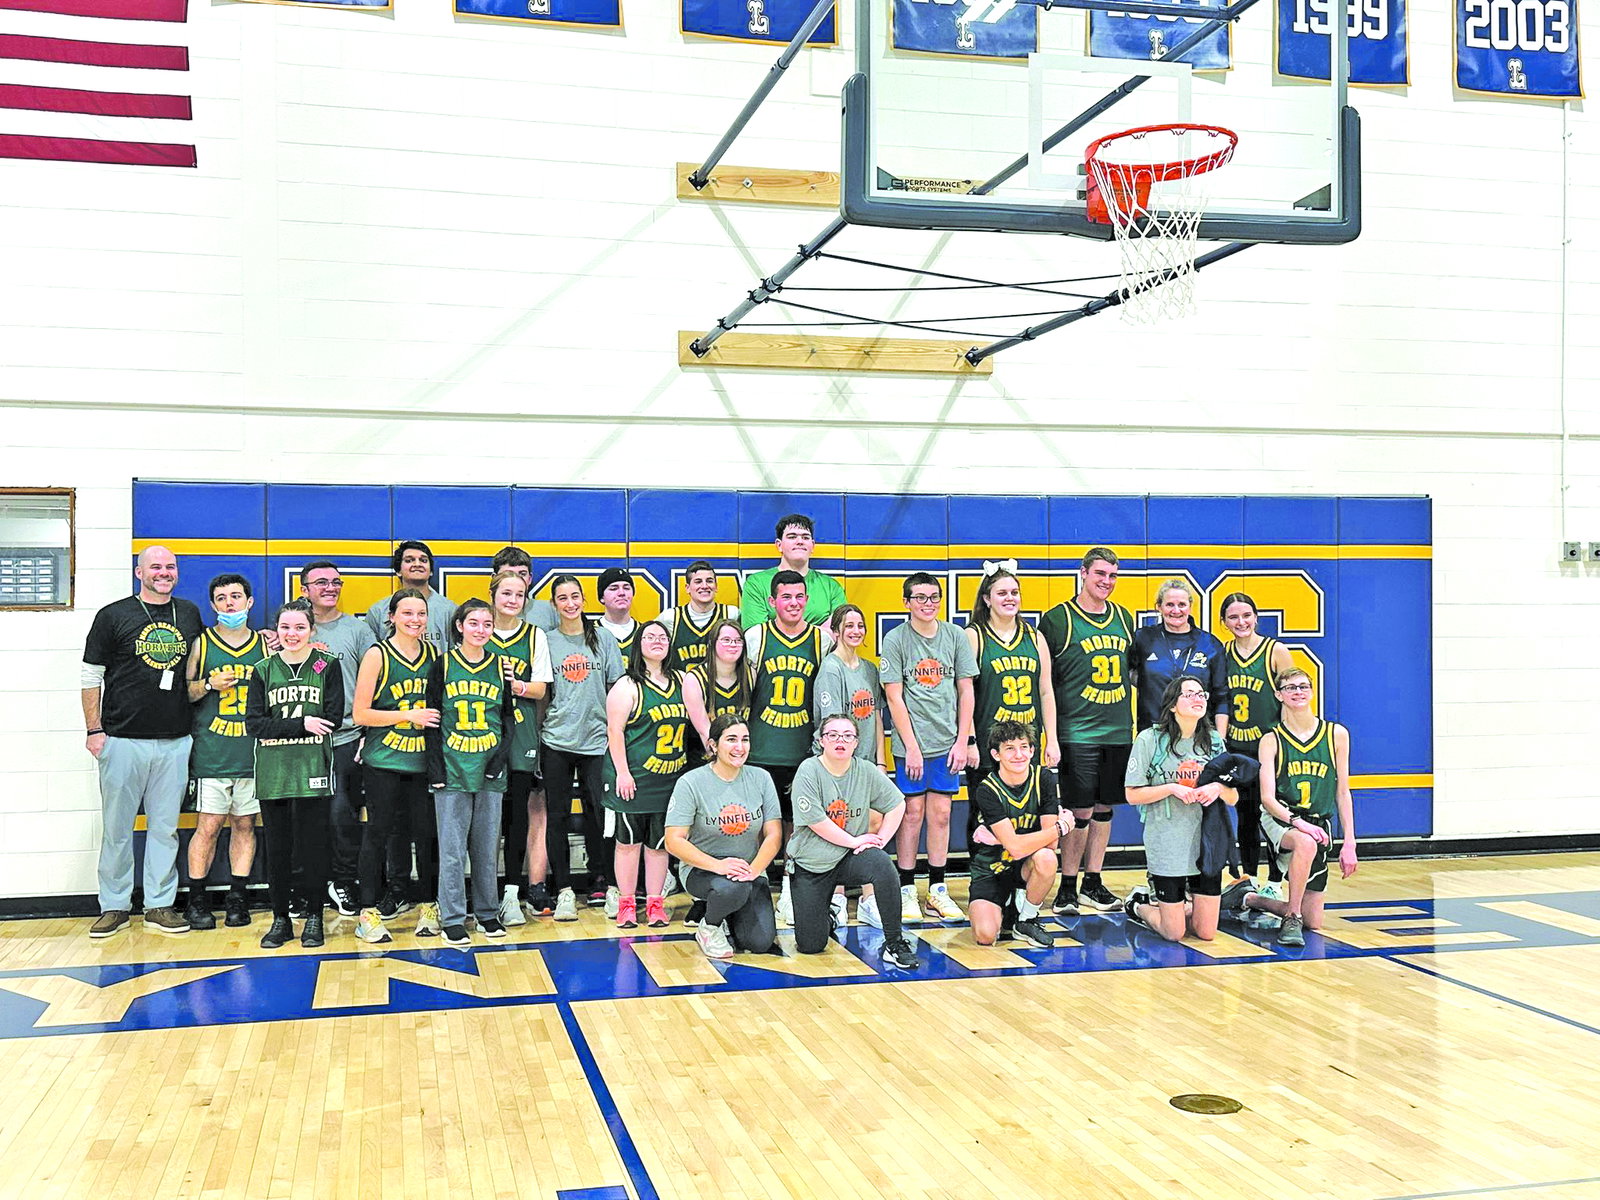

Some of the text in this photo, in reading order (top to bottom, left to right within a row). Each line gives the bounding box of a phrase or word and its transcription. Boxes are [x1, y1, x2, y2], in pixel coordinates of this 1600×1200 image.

[1465, 0, 1569, 53] 2003
[904, 178, 961, 189] PERFORMANCE
[1080, 634, 1127, 655] NORTH
[764, 655, 815, 678] NORTH
[990, 655, 1037, 674] NORTH
[1091, 654, 1122, 684] 31
[268, 685, 321, 707] NORTH
[445, 679, 500, 701] NORTH
[770, 675, 806, 707] 10
[1001, 675, 1033, 706] 32
[1080, 684, 1127, 705] READING
[453, 700, 489, 731] 11
[759, 706, 809, 729] READING
[993, 705, 1037, 725] READING
[1233, 693, 1250, 723] 3
[446, 731, 498, 753] READING
[655, 723, 686, 755] 24
[1228, 724, 1263, 742] EADING
[1287, 760, 1329, 779] NORTH
[1296, 781, 1312, 809] 1
[705, 811, 762, 826] LYNNFIELD
